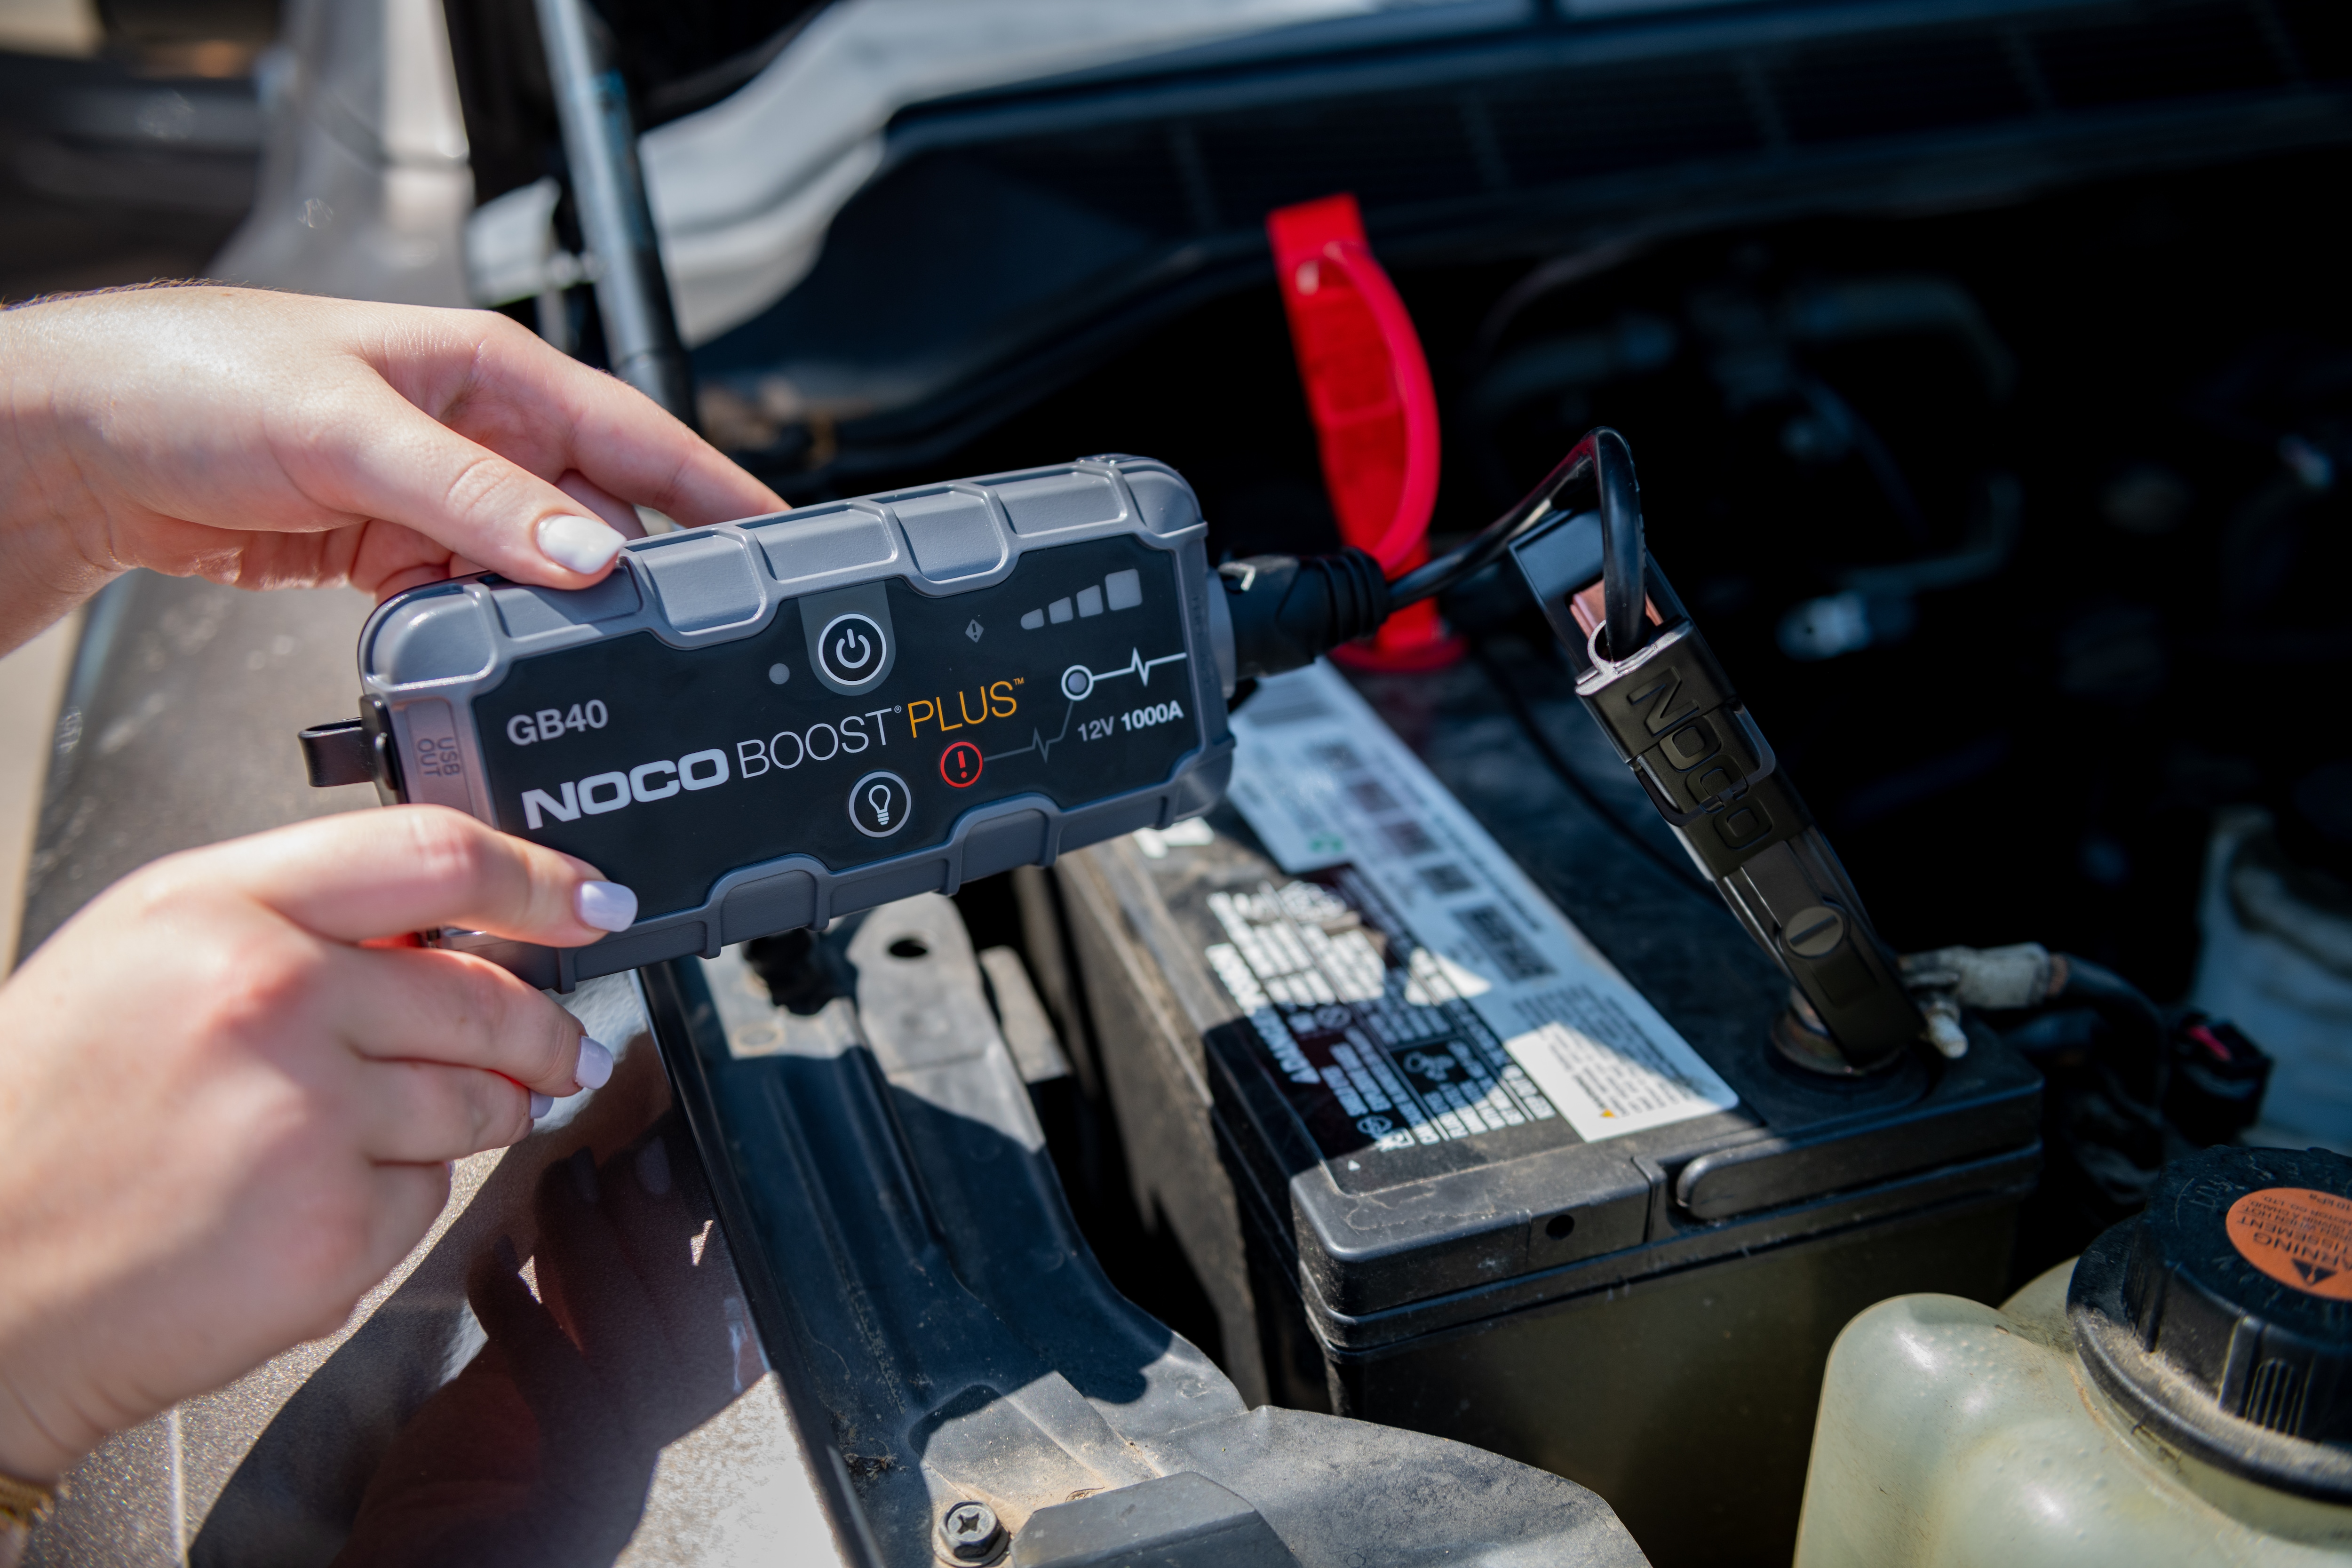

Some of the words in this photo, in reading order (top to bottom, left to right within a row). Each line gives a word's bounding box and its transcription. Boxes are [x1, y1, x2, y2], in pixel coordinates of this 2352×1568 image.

[507, 699, 609, 746] GB40
[1077, 716, 1114, 742] 12V
[1121, 700, 1184, 732] 1000A
[417, 738, 442, 777] OUT
[436, 736, 461, 777] USB
[1627, 666, 1773, 850] NOCO
[521, 748, 730, 830] NOCO
